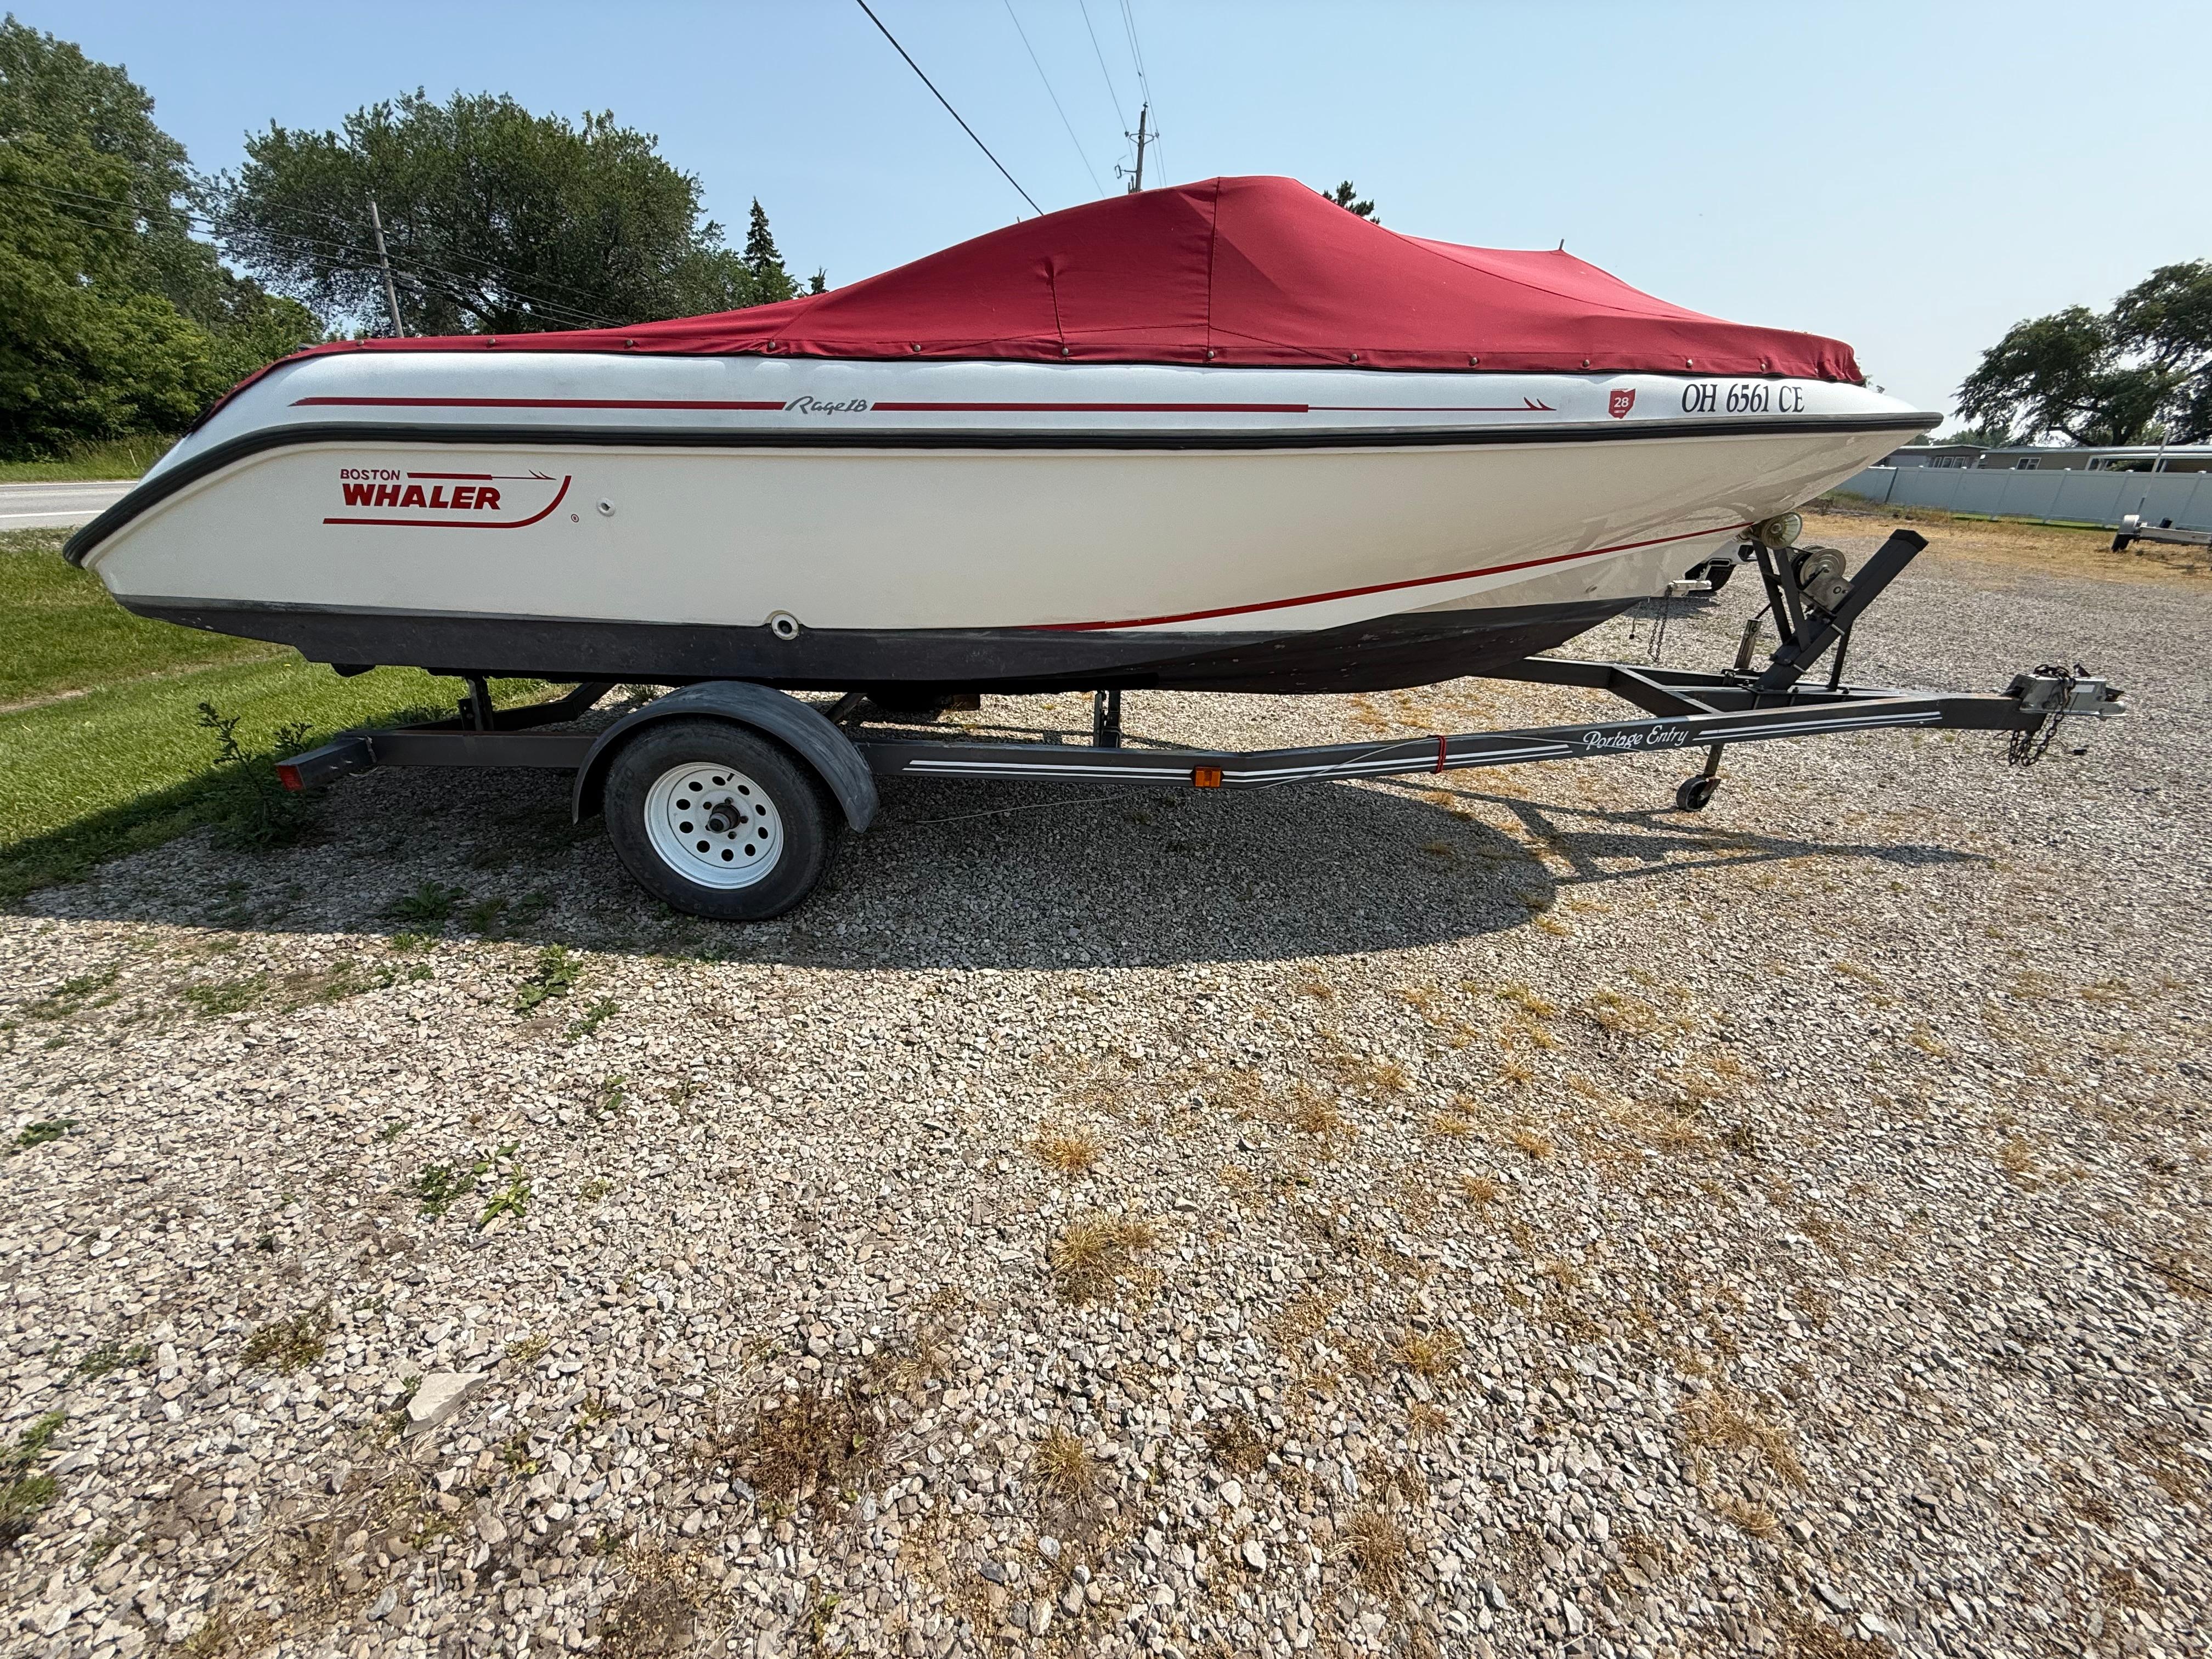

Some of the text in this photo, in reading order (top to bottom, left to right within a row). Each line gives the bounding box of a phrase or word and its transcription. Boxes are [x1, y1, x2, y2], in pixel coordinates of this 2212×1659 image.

[1613, 397, 1629, 408] 28
[1681, 383, 1805, 413] OH 6561 CE
[340, 469, 400, 481] BOSTON
[342, 483, 501, 510] WHALER
[1583, 725, 1689, 751] Portage Entry
